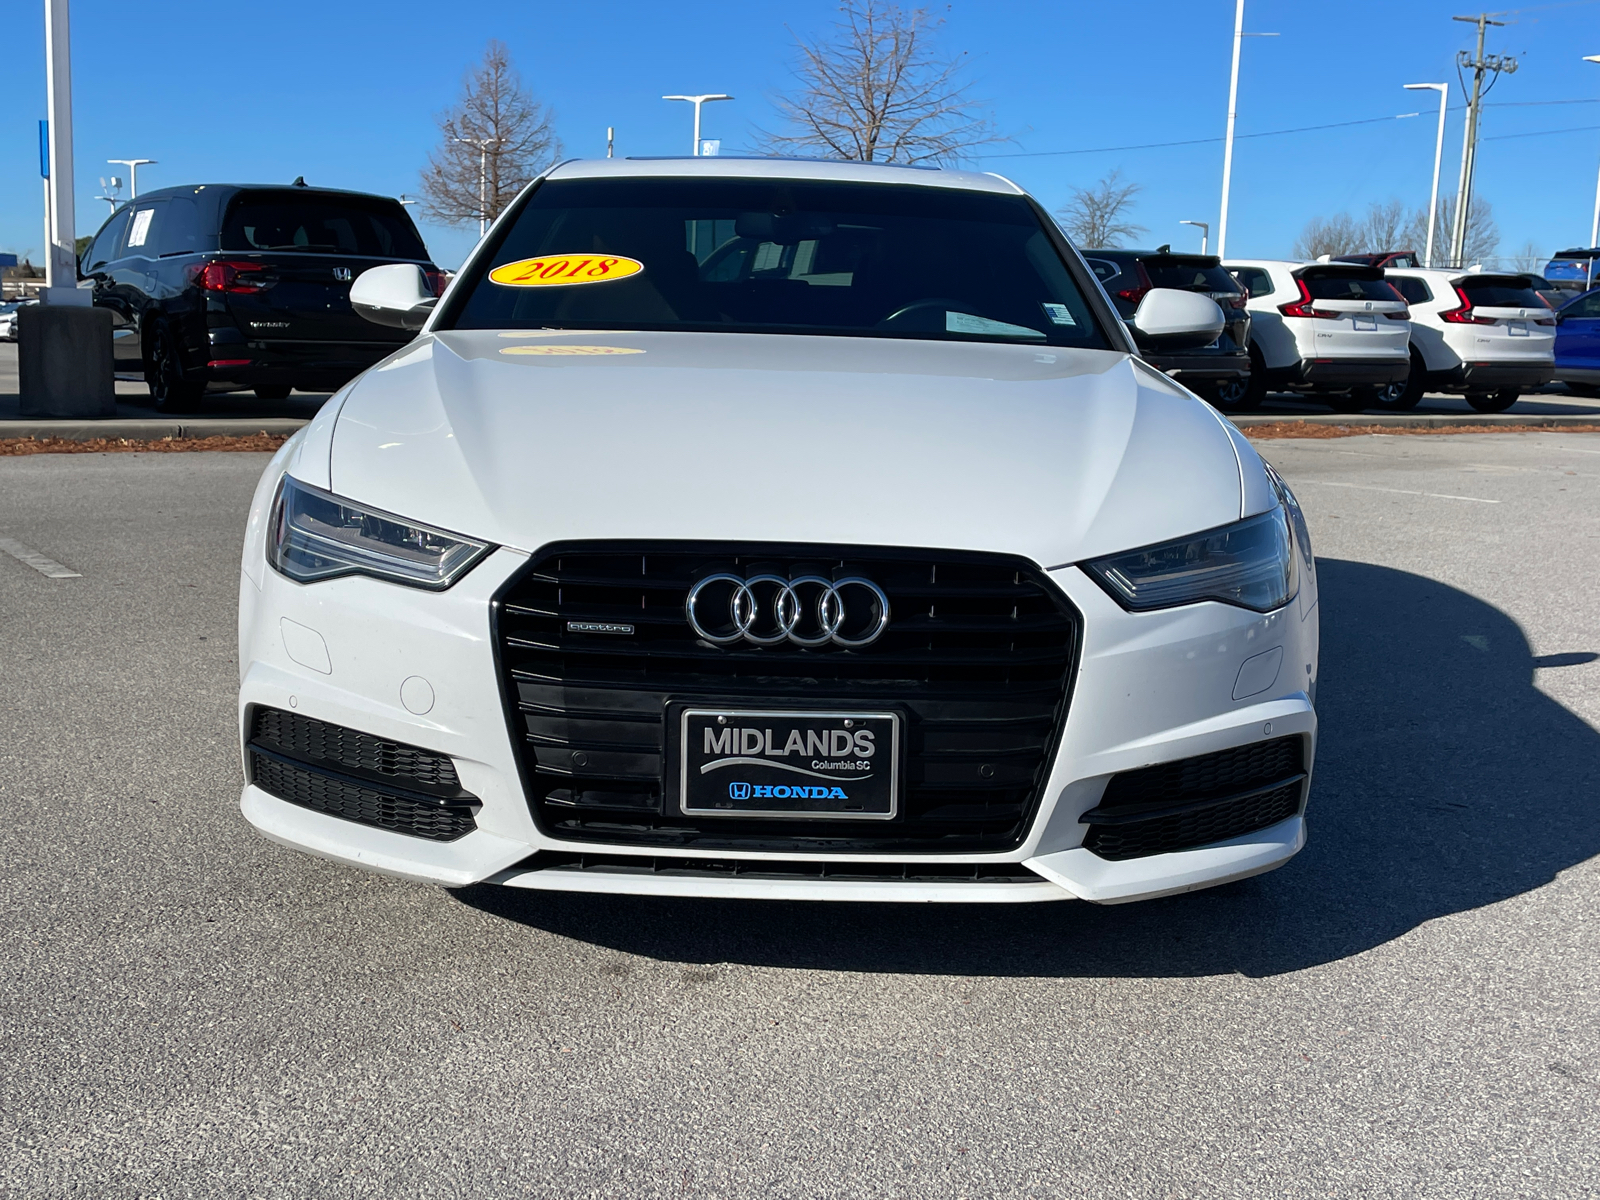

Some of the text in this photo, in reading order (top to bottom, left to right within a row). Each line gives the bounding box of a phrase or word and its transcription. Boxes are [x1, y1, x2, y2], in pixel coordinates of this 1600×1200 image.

[511, 259, 619, 281] 2018
[570, 623, 631, 632] quattro
[704, 727, 875, 758] MIDLANDS
[812, 760, 871, 771] Columbia SC
[753, 785, 848, 799] HONDA
